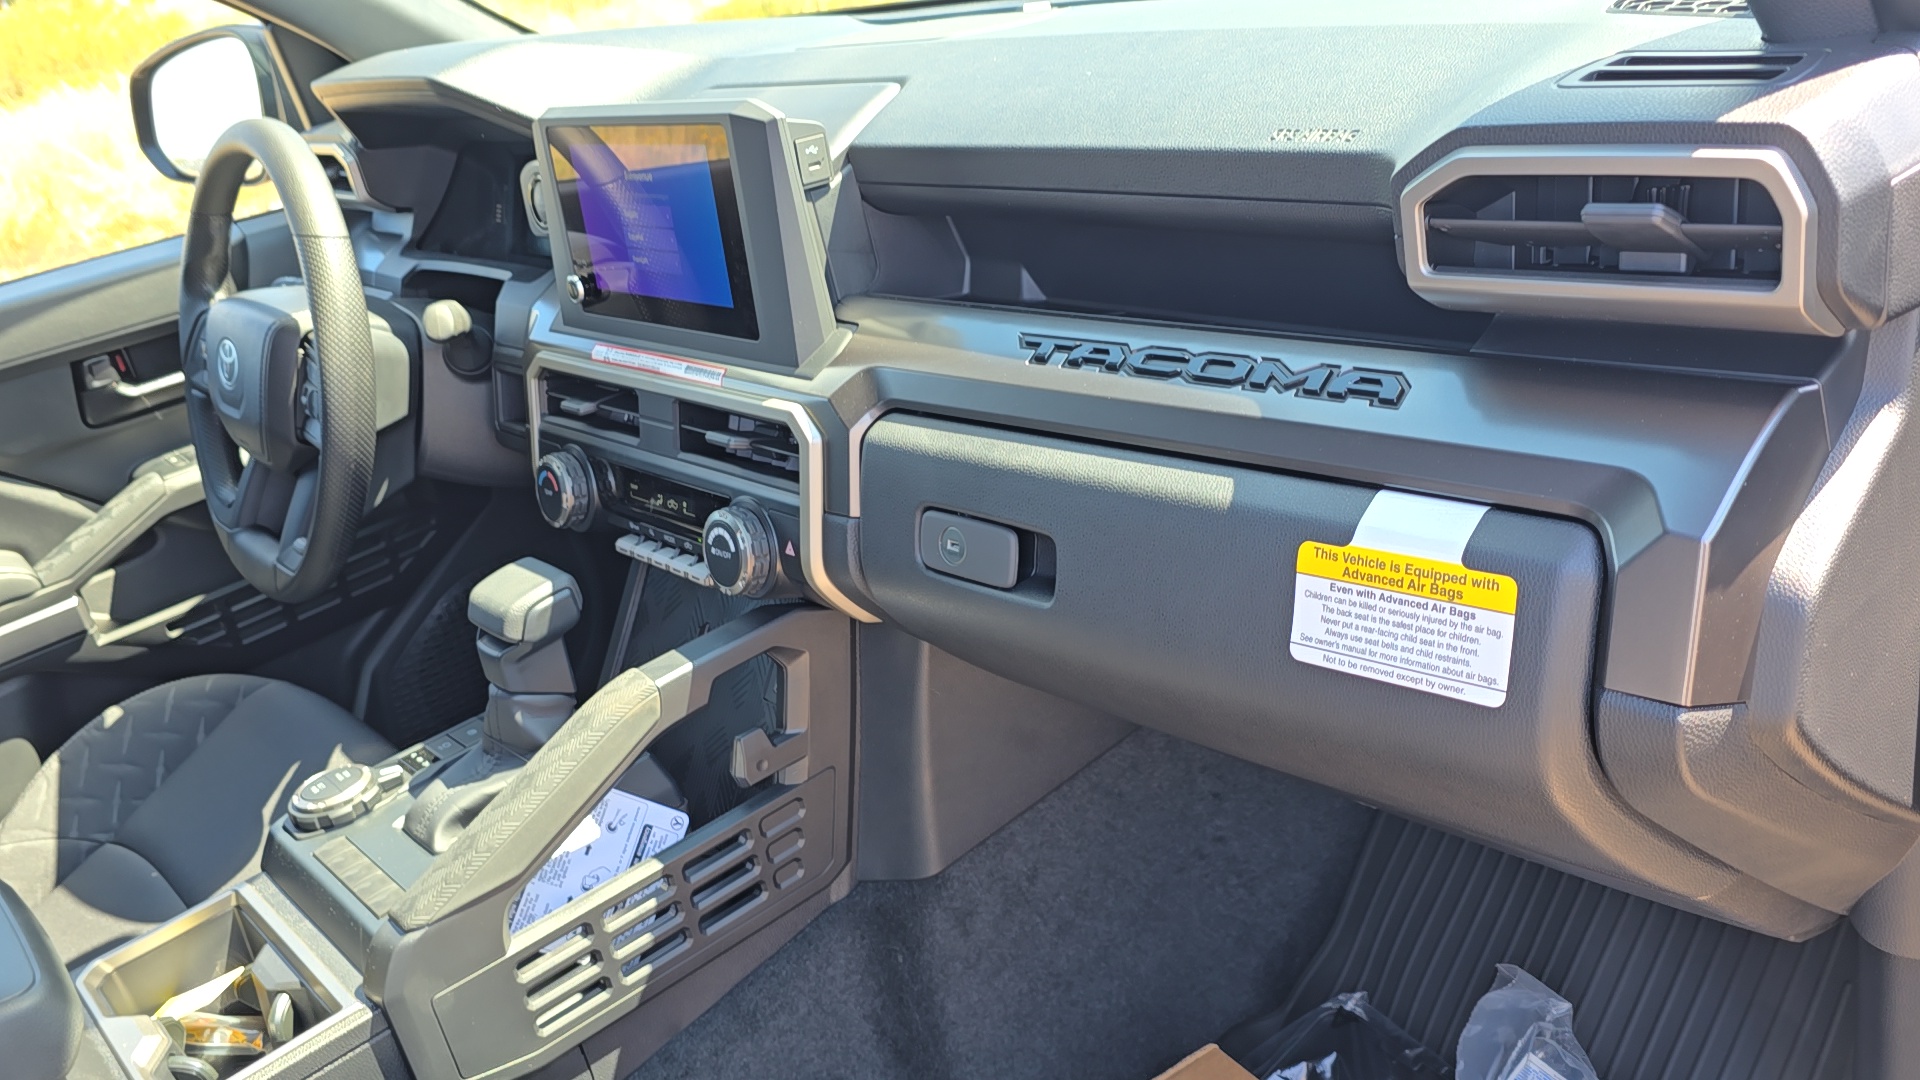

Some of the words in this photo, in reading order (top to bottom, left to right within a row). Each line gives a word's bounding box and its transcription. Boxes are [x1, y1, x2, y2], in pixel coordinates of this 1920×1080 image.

[1018, 332, 1412, 410] TACOMA
[1314, 546, 1338, 562] This
[1343, 552, 1386, 570] Vehicle
[1390, 560, 1400, 574] is
[1404, 563, 1467, 587] Equipped
[1472, 575, 1500, 592] with
[1342, 567, 1404, 588] Advanced
[1407, 578, 1426, 593] Air
[1430, 582, 1463, 600] Bags
[1304, 589, 1332, 602] Children
[1334, 596, 1346, 604] can
[1348, 598, 1357, 607] be
[1359, 600, 1377, 612] killed
[1379, 606, 1386, 614] or
[1388, 607, 1420, 622] seriously
[1422, 613, 1447, 626] injured
[1449, 619, 1458, 630] by
[1460, 622, 1472, 631] the
[1474, 624, 1484, 634] air
[1486, 626, 1504, 639] bag.
[1330, 582, 1353, 595] Even
[1356, 589, 1376, 600] with
[1378, 592, 1428, 610] Advanced
[1431, 603, 1446, 614] Air
[1450, 606, 1476, 620] Bags
[1320, 614, 1340, 626] Never
[1342, 621, 1354, 630] put
[1361, 625, 1398, 641] rear-facing
[1400, 633, 1418, 644] child
[1419, 637, 1435, 647] seat
[1437, 640, 1444, 650] in
[1446, 642, 1458, 652] the
[1460, 646, 1480, 657] front.
[1322, 604, 1334, 614] The
[1336, 608, 1352, 618] back
[1354, 612, 1369, 622] seat
[1371, 614, 1376, 623] is
[1379, 616, 1390, 626] the
[1392, 619, 1414, 630] safest
[1415, 624, 1435, 636] place
[1437, 628, 1446, 638] for
[1448, 632, 1481, 645] children.
[1300, 632, 1314, 642] See
[1314, 638, 1340, 650] owner's
[1342, 644, 1367, 655] manual
[1369, 648, 1378, 658] for
[1380, 652, 1398, 662] more
[1400, 655, 1440, 672] information
[1442, 666, 1464, 678] about
[1466, 671, 1476, 680] air
[1478, 673, 1499, 686] bags.
[1324, 627, 1348, 640] Always
[1350, 634, 1360, 643] use
[1364, 638, 1380, 646] seat
[1381, 640, 1398, 652] belts
[1400, 645, 1414, 654] and
[1416, 648, 1433, 659] child
[1435, 652, 1472, 668] restraints.
[1322, 654, 1336, 664] Not
[1338, 658, 1346, 667] to
[1348, 660, 1358, 668] be
[1360, 664, 1394, 678] removed
[1396, 672, 1424, 685] except
[1426, 678, 1436, 690] by
[1438, 682, 1466, 696] owner.
